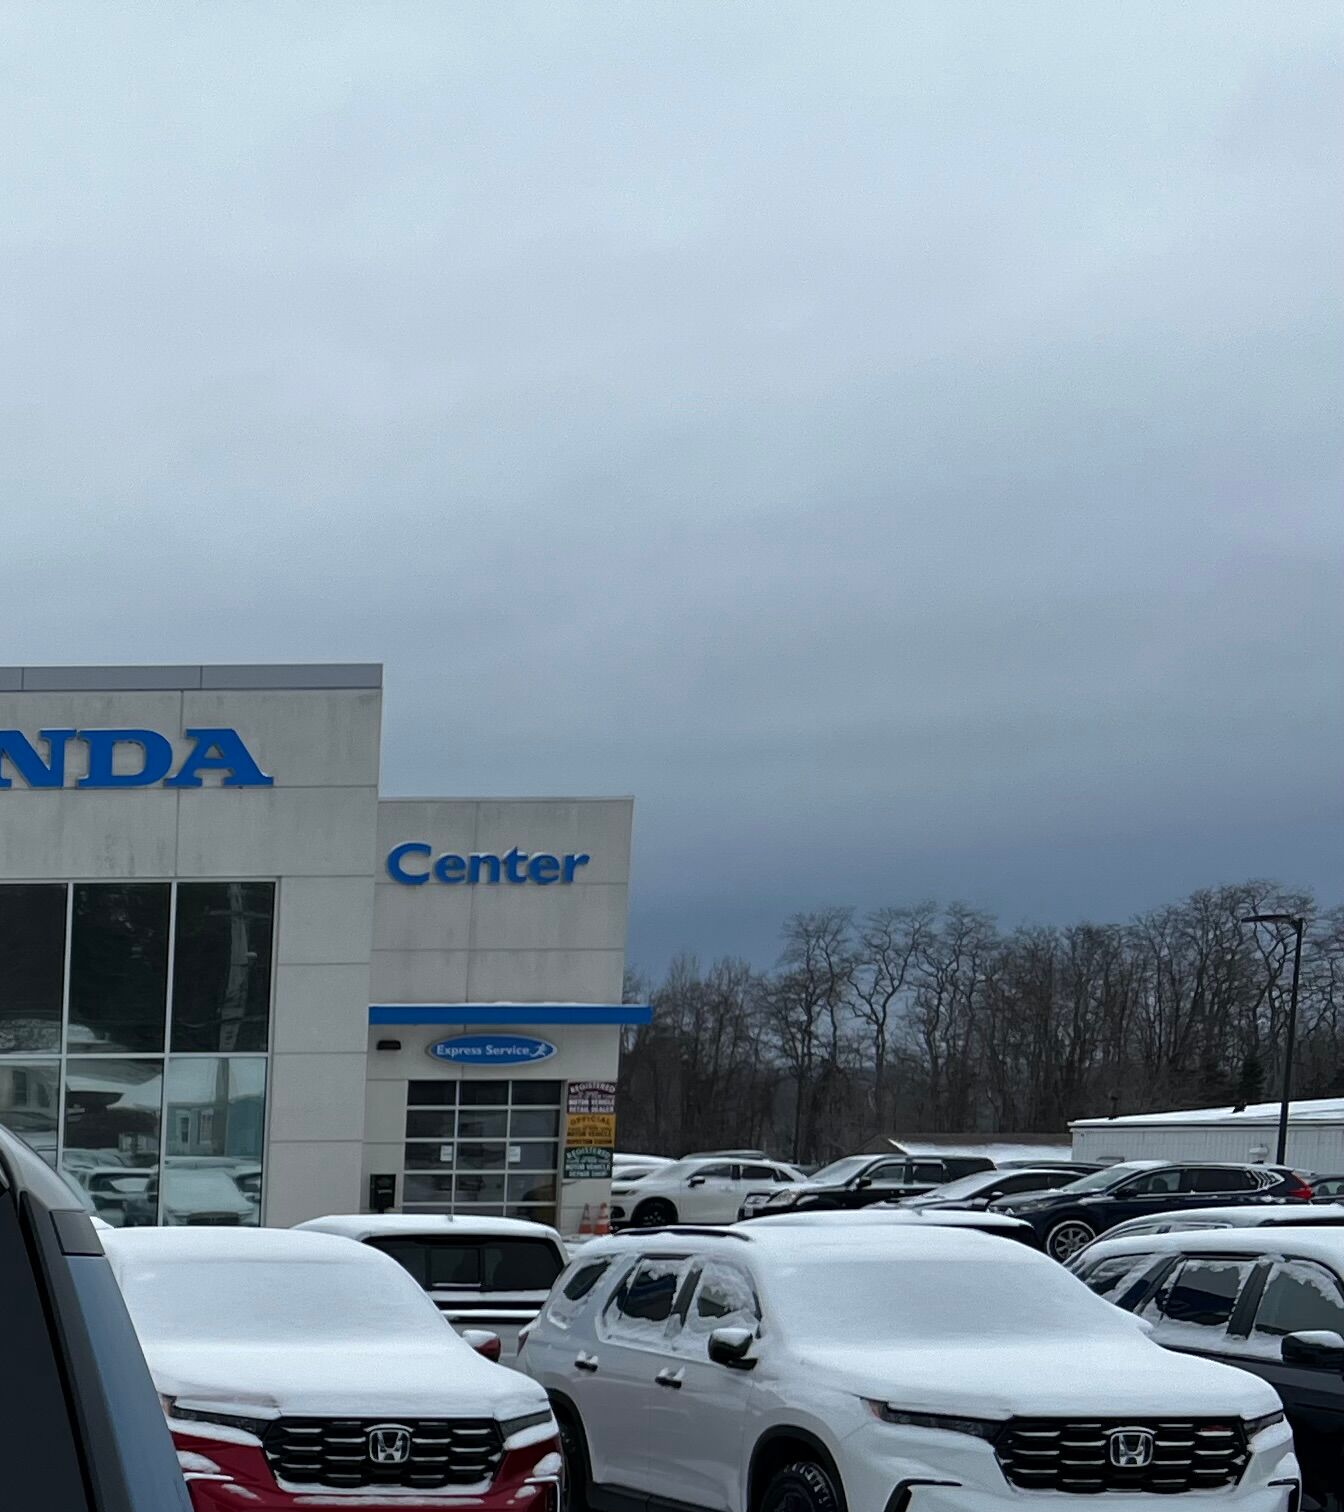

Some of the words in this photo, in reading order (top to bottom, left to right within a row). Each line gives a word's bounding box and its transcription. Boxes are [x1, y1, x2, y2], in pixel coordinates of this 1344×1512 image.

[387, 841, 591, 886] Center
[436, 1044, 482, 1058] Express
[485, 1044, 530, 1056] Service
